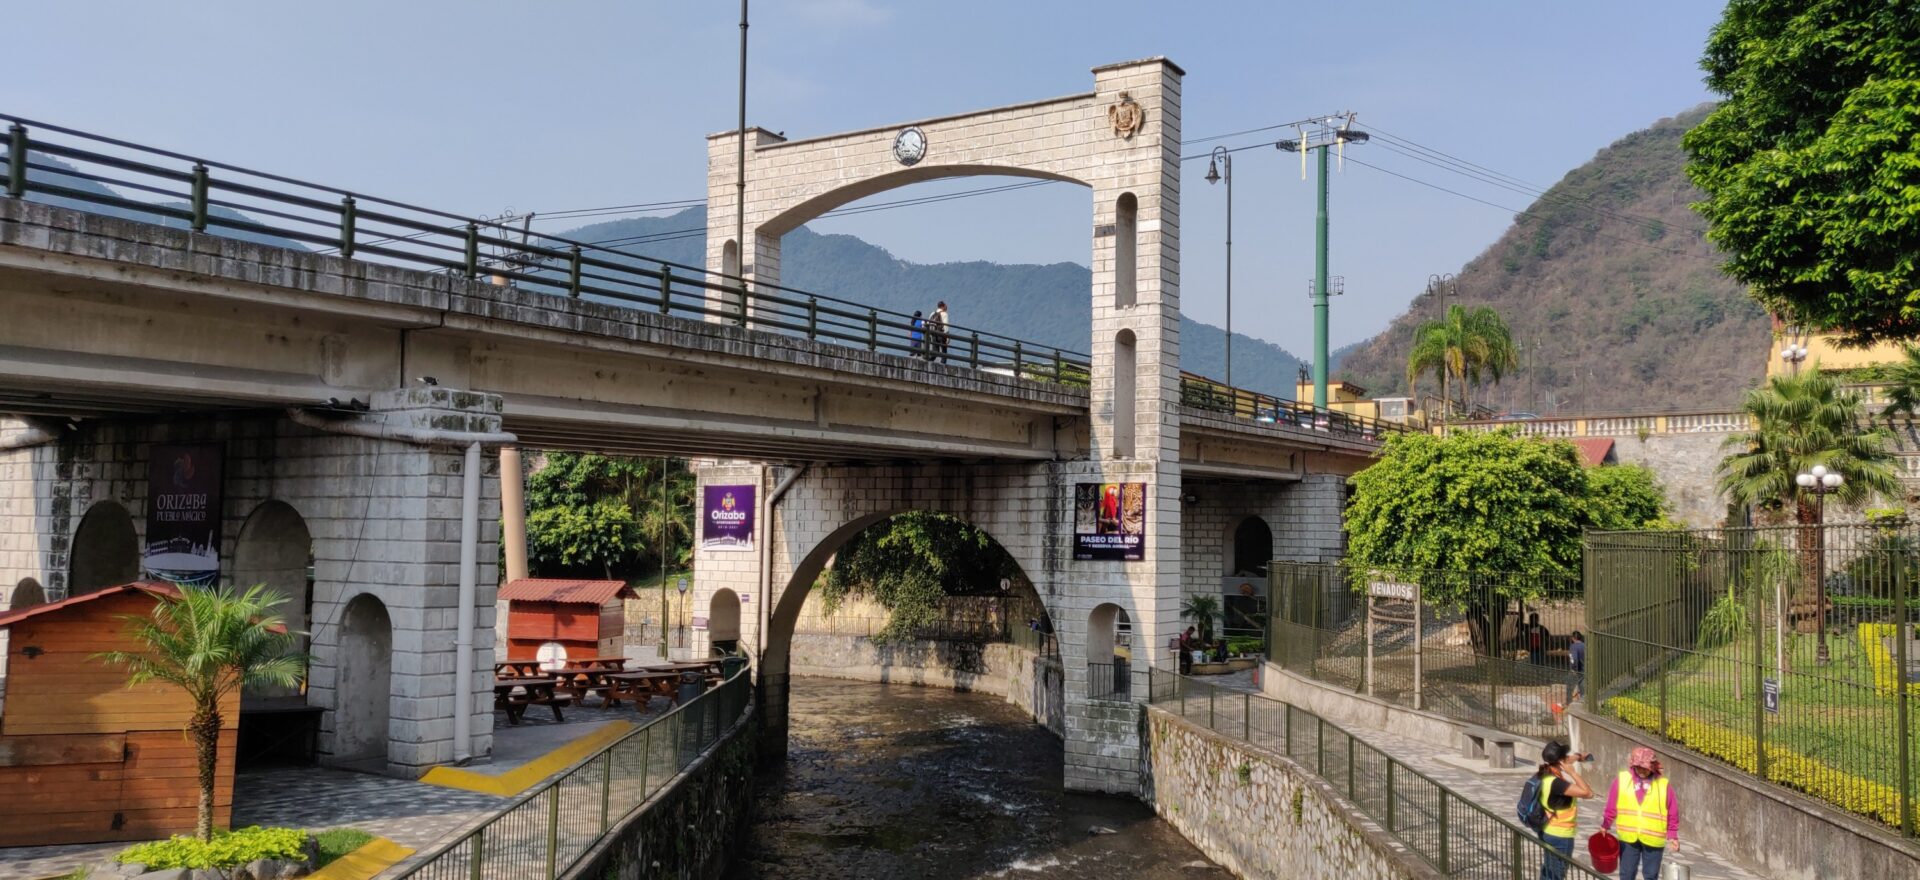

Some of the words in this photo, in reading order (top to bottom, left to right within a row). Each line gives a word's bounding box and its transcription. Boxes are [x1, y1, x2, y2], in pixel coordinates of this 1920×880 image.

[711, 510, 746, 520] Orizaba
[1124, 535, 1140, 544] RÍO
[1371, 582, 1406, 597] VENADOS
